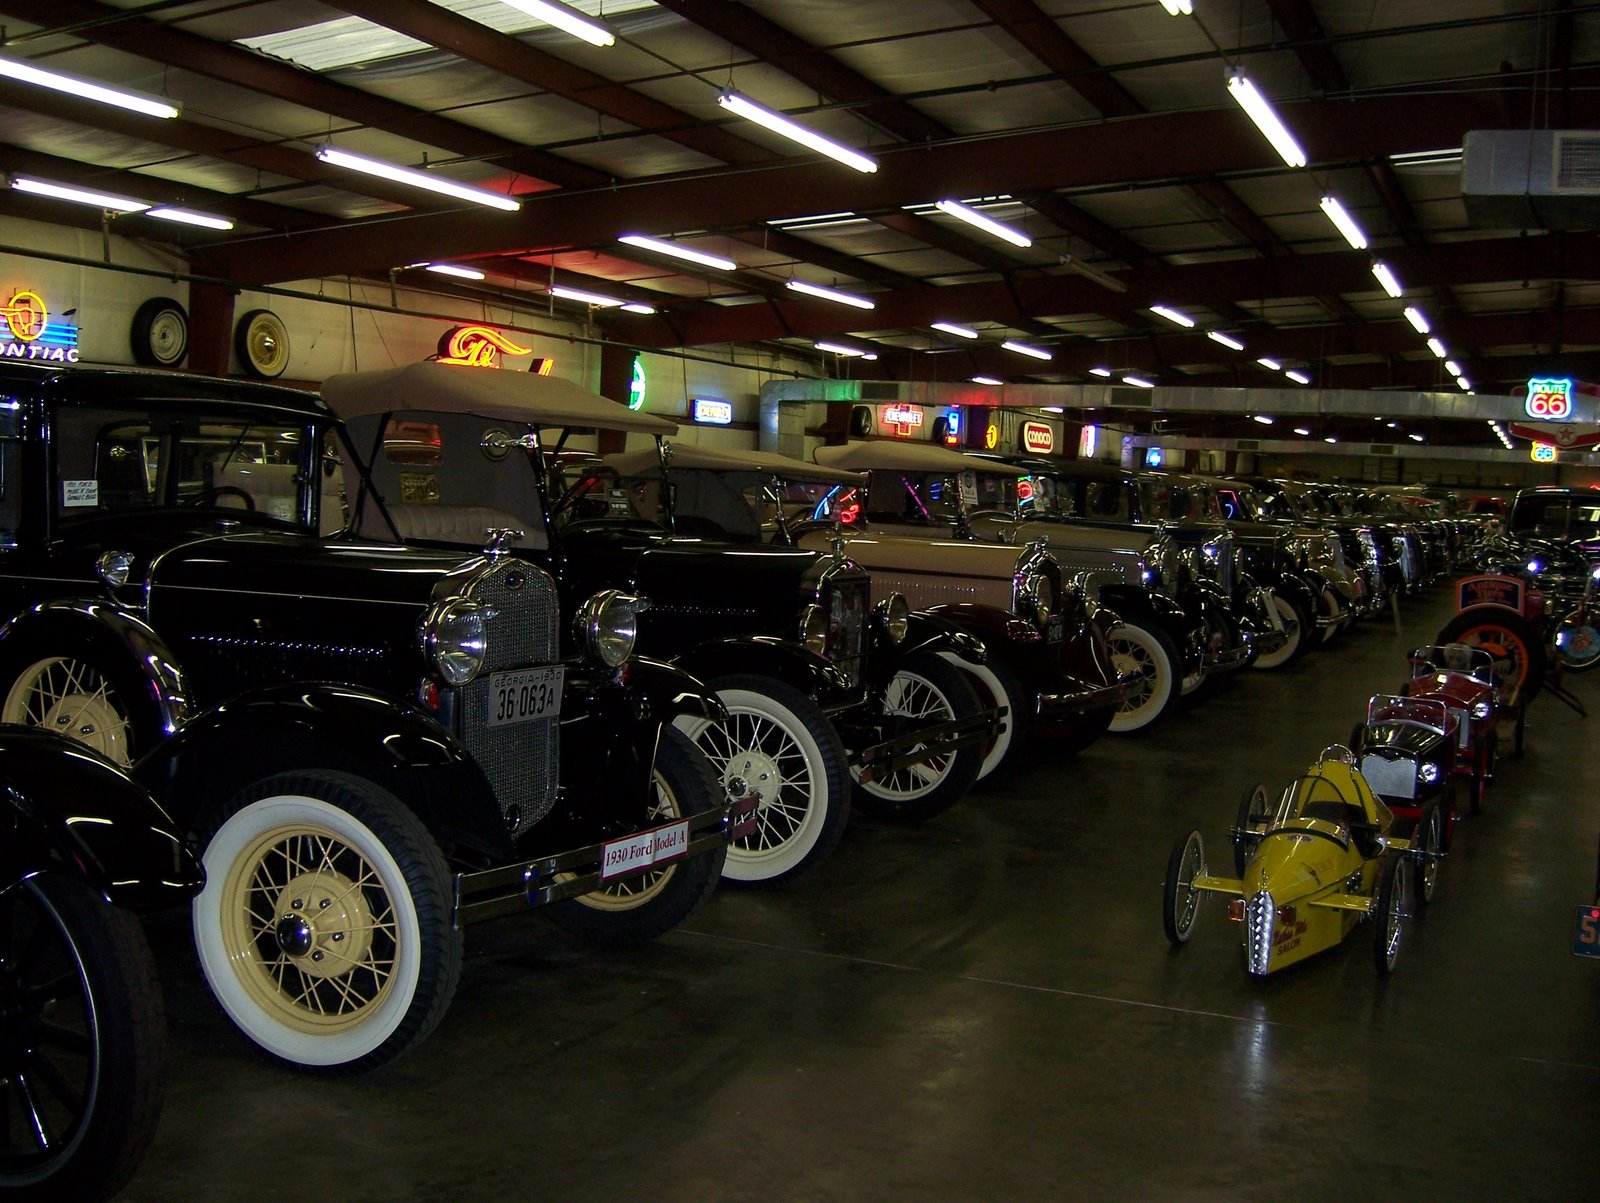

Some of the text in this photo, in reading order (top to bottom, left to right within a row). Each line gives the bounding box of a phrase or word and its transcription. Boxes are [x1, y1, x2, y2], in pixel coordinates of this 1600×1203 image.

[1533, 383, 1566, 394] ROUTE
[1531, 393, 1566, 415] 66
[1028, 430, 1051, 445] CONOCO
[605, 847, 628, 867] 1930
[629, 839, 653, 860] Ford
[678, 829, 685, 844] A
